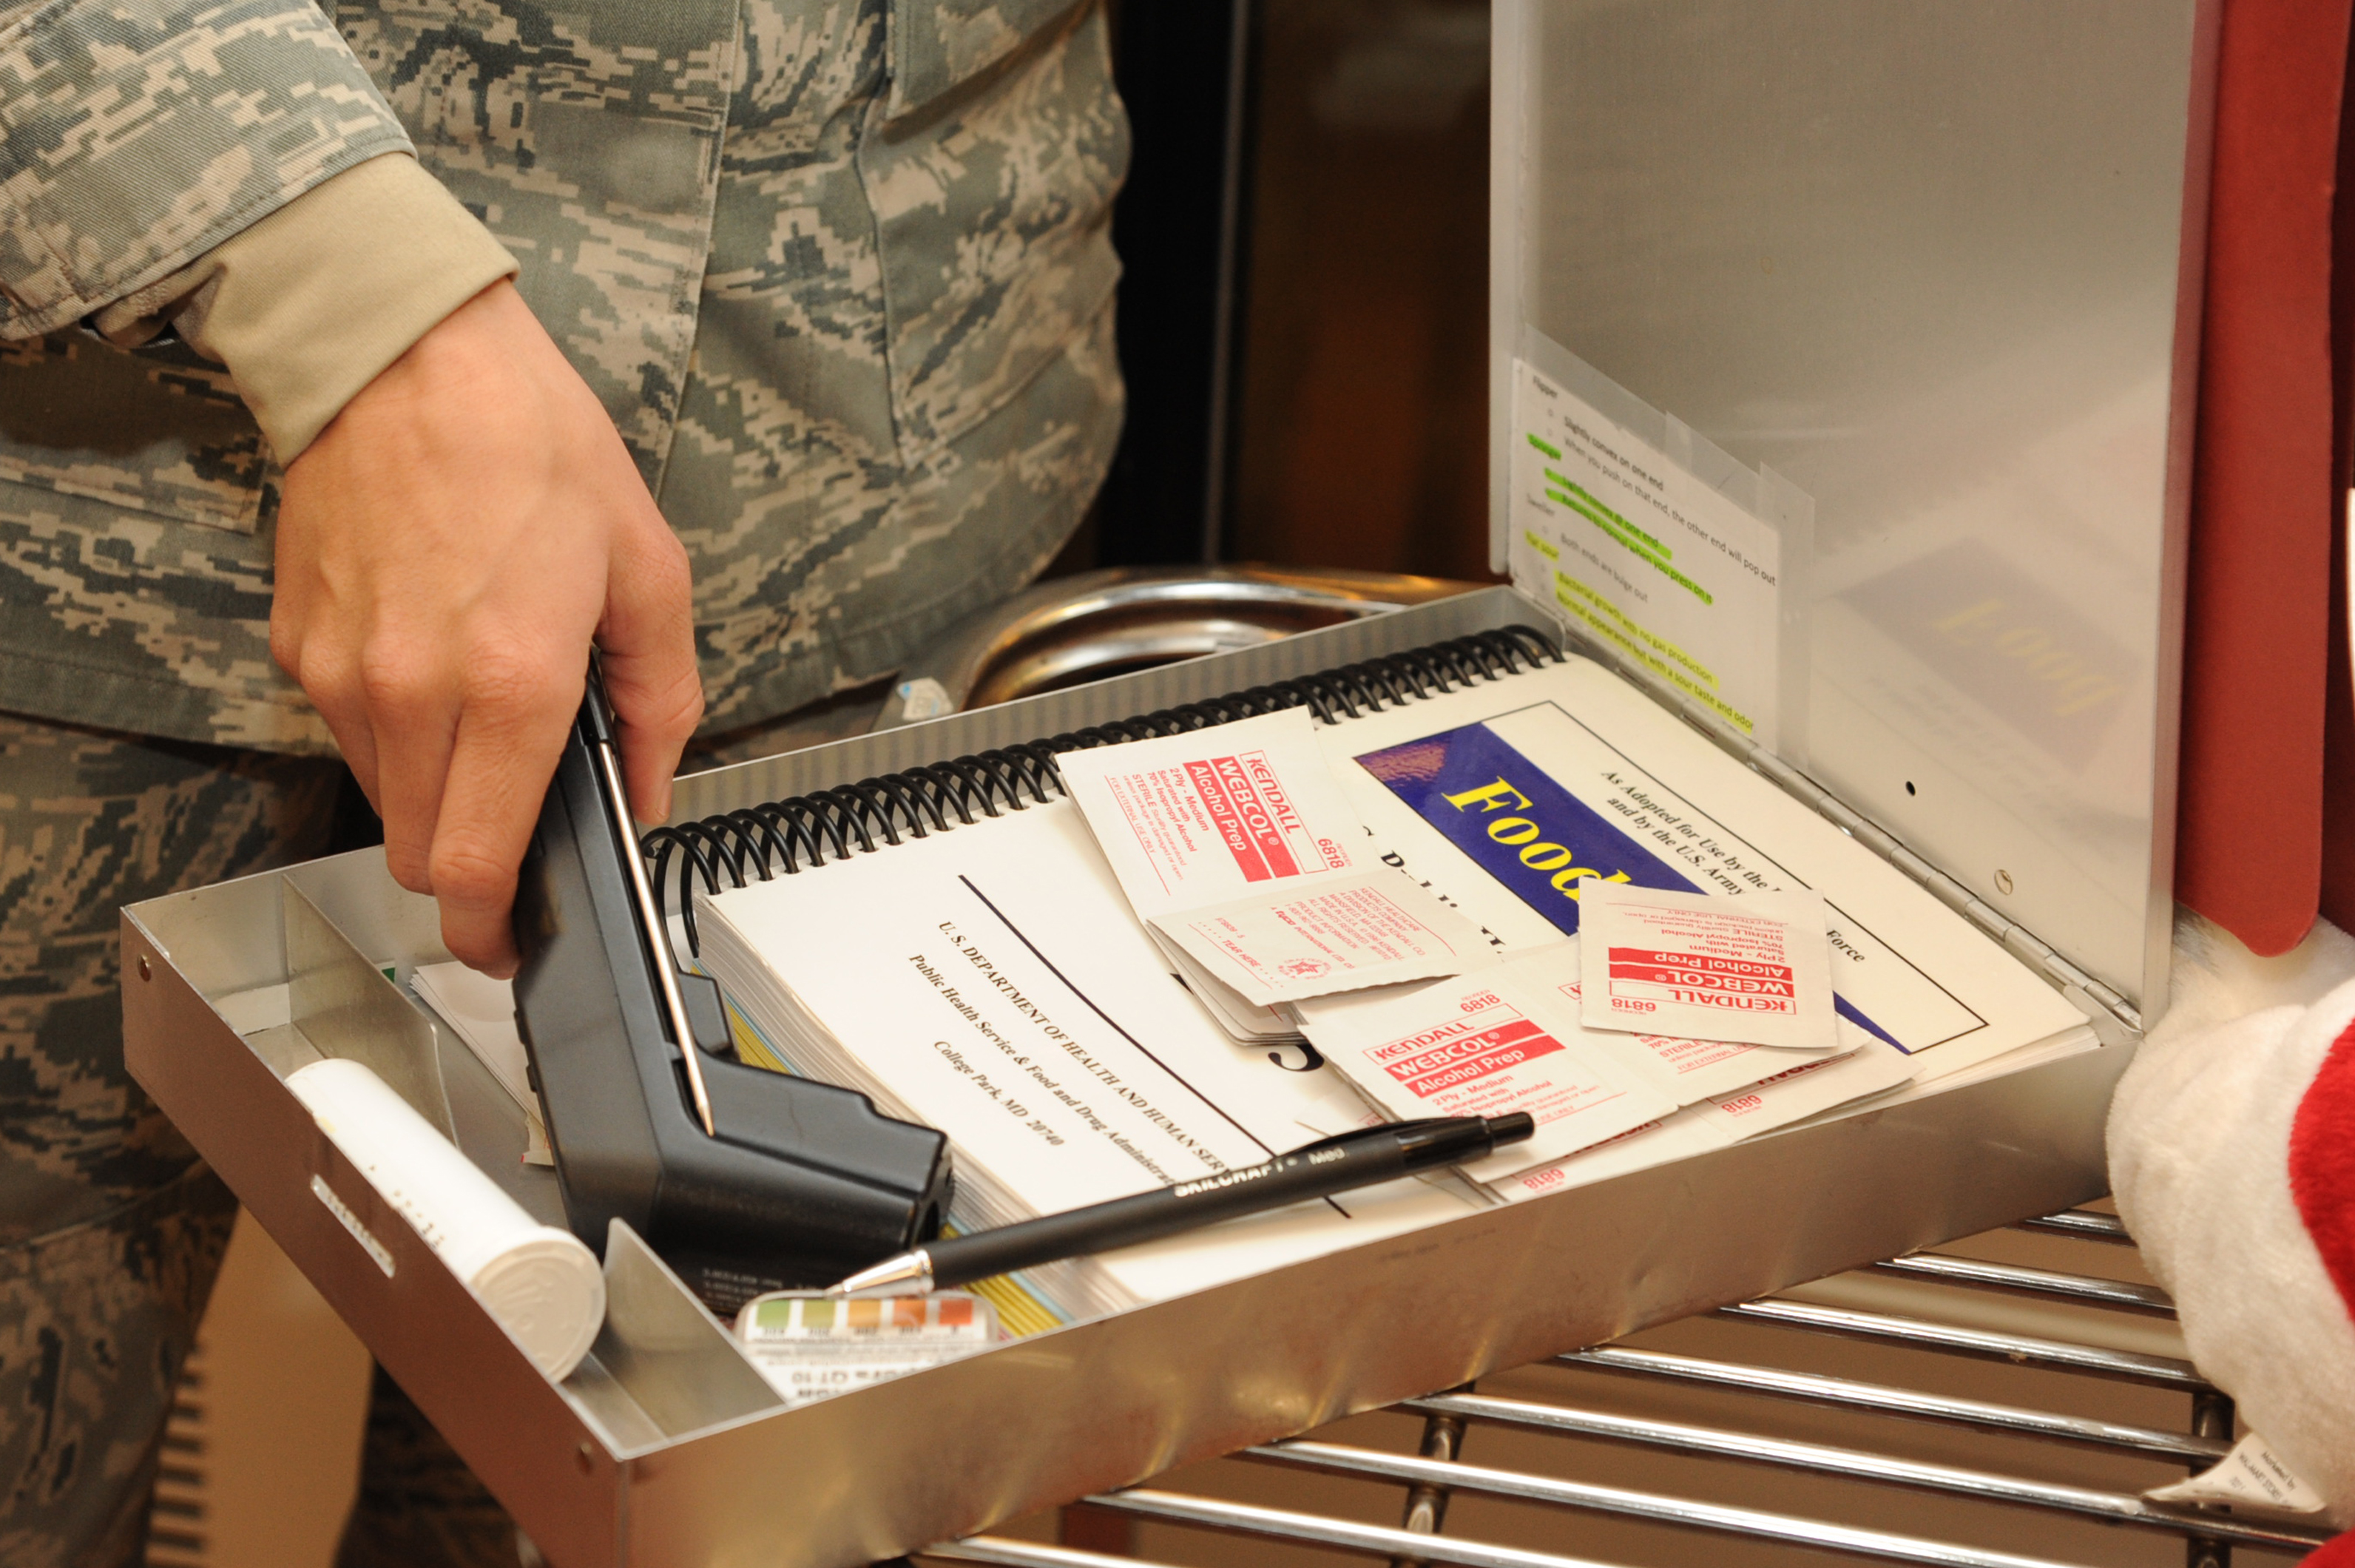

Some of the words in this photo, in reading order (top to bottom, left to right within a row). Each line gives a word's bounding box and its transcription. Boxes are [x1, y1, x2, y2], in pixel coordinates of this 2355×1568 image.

[1592, 438, 1618, 462] convex
[1620, 456, 1630, 469] on
[1632, 464, 1647, 480] one
[1649, 475, 1663, 491] end
[1587, 456, 1601, 470] you
[1602, 465, 1621, 484] push
[1622, 479, 1633, 491] on
[1635, 485, 1651, 504] that
[1652, 498, 1670, 517] end,
[1672, 510, 1686, 526] the
[1686, 520, 1709, 541] other
[1711, 536, 1726, 552] end
[1728, 547, 1742, 564] will
[1743, 558, 1760, 575] pop
[1760, 570, 1776, 587] out
[1625, 521, 1641, 536] one
[1643, 532, 1659, 548] end
[1581, 548, 1600, 567] ends
[1633, 588, 1649, 604] out
[1628, 545, 1652, 564] when
[1653, 558, 1669, 575] you
[1670, 570, 1693, 590] press
[1694, 584, 1705, 600] on
[1705, 594, 1712, 604] it
[1639, 629, 1652, 643] no
[1652, 638, 1666, 654] gas
[1667, 648, 1714, 683] production
[1648, 655, 1667, 672] with
[1675, 672, 1693, 691] sour
[1694, 683, 1716, 705] taste
[1716, 700, 1733, 718] and
[1734, 712, 1754, 731] odor
[1132, 774, 1158, 808] STERILE
[1158, 769, 1183, 805] Saturated
[1178, 805, 1191, 822] with
[1246, 757, 1301, 834] KENDALL
[1147, 771, 1162, 787] 70%
[1156, 787, 1181, 823] Isopropyl
[1175, 823, 1197, 852] Alcohol
[1185, 795, 1210, 832] Medium
[1191, 765, 1232, 817] Alcohol
[1220, 818, 1247, 852] Prep
[1317, 837, 1345, 869] 6818
[1606, 796, 1638, 817] and
[1632, 810, 1655, 831] by
[1652, 825, 1677, 848] the
[1675, 842, 1706, 867] U.S.
[1702, 862, 1746, 896] Army
[1601, 769, 1621, 787] As
[1621, 779, 1680, 831] Adopted
[1675, 819, 1700, 839] for
[1699, 838, 1726, 859] Use
[1723, 854, 1745, 875] by
[1743, 866, 1768, 889] the
[1826, 927, 1866, 964] Force
[1275, 910, 1297, 926] tyco
[1660, 928, 1704, 939] Alcohol
[1689, 944, 1743, 957] Medium
[1705, 940, 1731, 949] with
[1706, 933, 1760, 946] Isopropyl
[1731, 943, 1785, 956] Saturated
[1732, 928, 1784, 942] STERILE
[1763, 941, 1785, 950] 70%
[1222, 939, 1243, 954] TEAR
[1239, 953, 1262, 968] HERE
[1654, 952, 1702, 968] Prep
[1708, 961, 1785, 978] Alcohol
[1459, 993, 1501, 1013] 6818
[1611, 998, 1657, 1013] 6818
[1667, 989, 1789, 1012] KENDALL
[908, 953, 946, 989] Public
[940, 987, 981, 1023] Health
[975, 1020, 1018, 1057] Service
[1013, 1055, 1031, 1066] &
[1025, 1064, 1061, 1090] Food
[1053, 1089, 1081, 1108] and
[1074, 1105, 1109, 1132] Drug
[962, 946, 1050, 1024] DEPARTMENT
[1044, 1024, 1070, 1042] OF
[1061, 1041, 1122, 1086] HEALTH
[1112, 1086, 1149, 1109] AND
[1142, 1106, 1201, 1148] HUMAN
[1373, 1022, 1476, 1061] KENDALL
[1416, 1061, 1483, 1094] Alcohol
[1479, 1049, 1526, 1070] Prep
[1466, 1074, 1515, 1095] Medium
[933, 1040, 975, 1075] College
[970, 1073, 1003, 1101] Park,
[1000, 1098, 1030, 1118] MD
[1025, 1119, 1066, 1147] 20740
[1442, 1095, 1489, 1114] Saturated
[1487, 1087, 1510, 1099] with
[1471, 1092, 1517, 1113] Isopropyl
[1516, 1080, 1555, 1098] Alcohol
[1721, 1094, 1763, 1114] 6818
[1523, 1168, 1565, 1190] 6818
